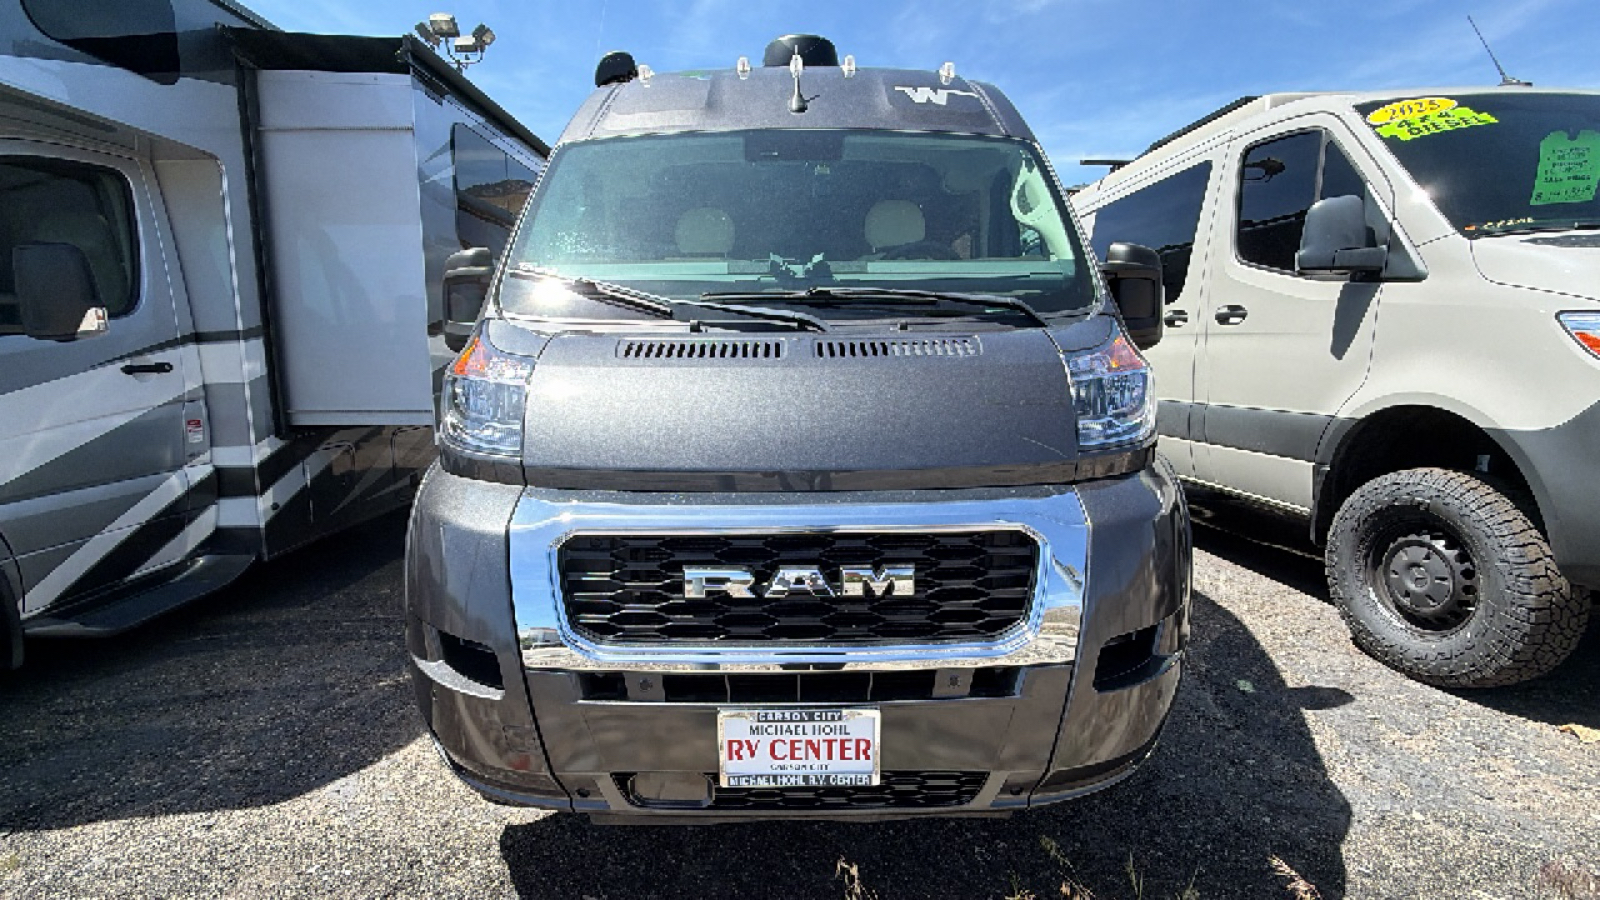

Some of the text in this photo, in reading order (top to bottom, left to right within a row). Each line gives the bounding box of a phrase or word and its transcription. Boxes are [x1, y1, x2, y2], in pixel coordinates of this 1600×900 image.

[683, 565, 915, 598] RAM
[758, 711, 841, 721] CARSON CITY
[750, 724, 851, 736] MICHAEL HOHL
[727, 738, 872, 761] RV CENTER
[770, 763, 830, 771] CARSON CITY
[729, 775, 776, 786] MICHAEL
[779, 775, 805, 786] HOHL
[829, 775, 870, 786] CENTER
